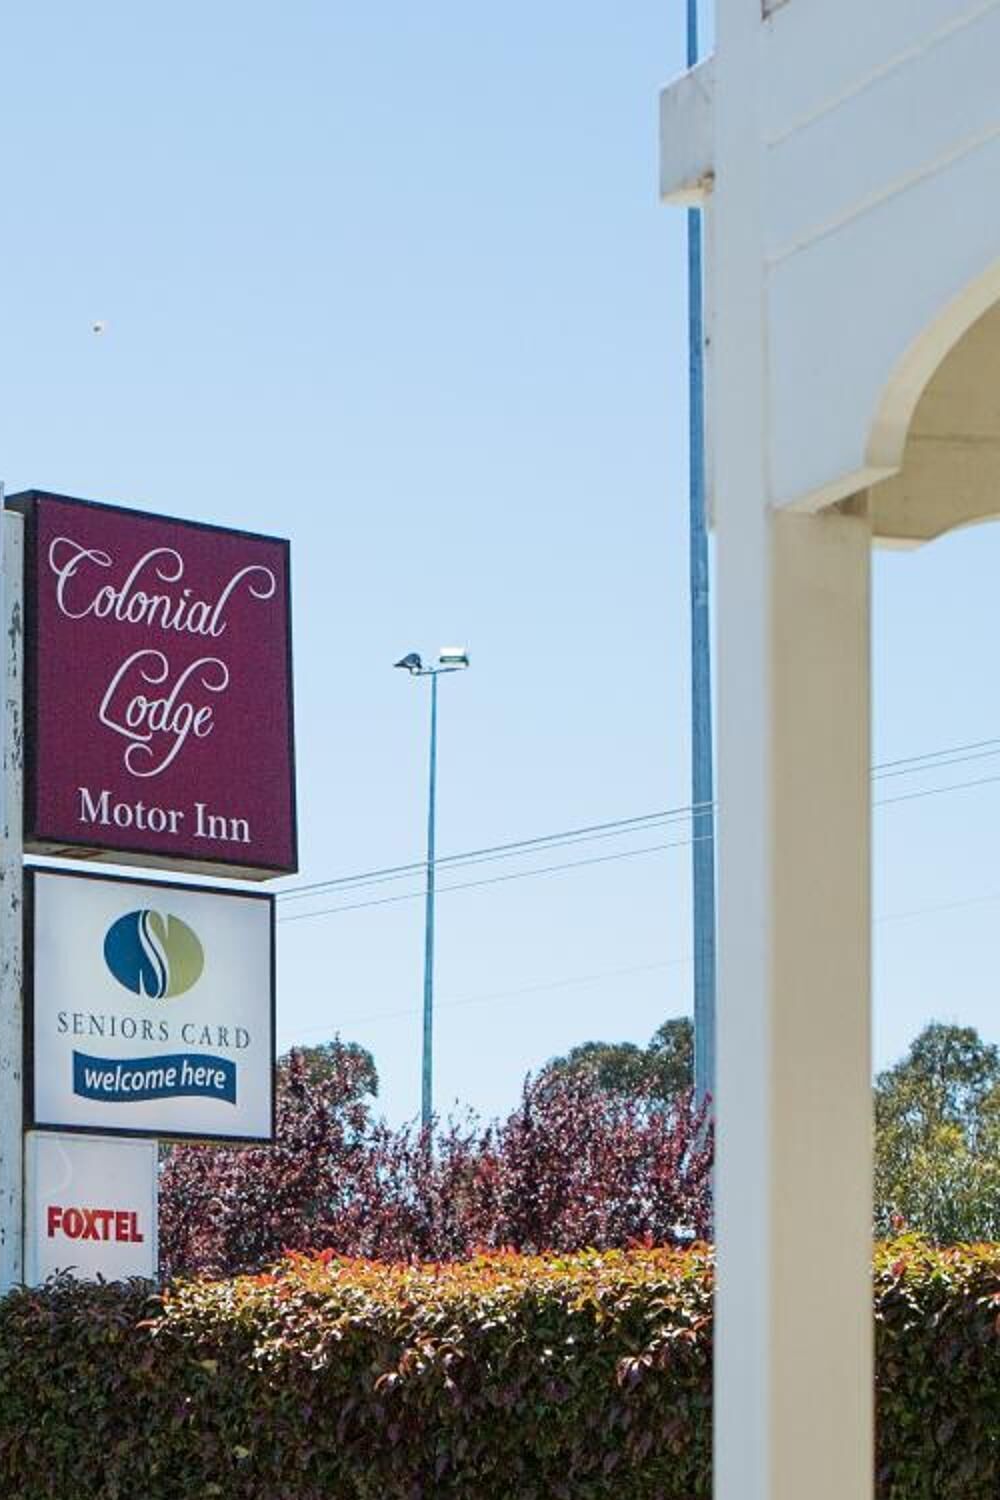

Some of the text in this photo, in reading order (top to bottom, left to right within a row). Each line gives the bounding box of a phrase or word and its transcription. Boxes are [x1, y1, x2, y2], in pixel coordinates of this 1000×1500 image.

[49, 537, 275, 637] Colonial
[99, 649, 229, 777] Lodge
[78, 787, 251, 842] Motor Inn
[57, 1011, 250, 1049] SENIORS CARD
[85, 1060, 226, 1092] welcome here
[47, 1205, 143, 1243] FOXTEL
